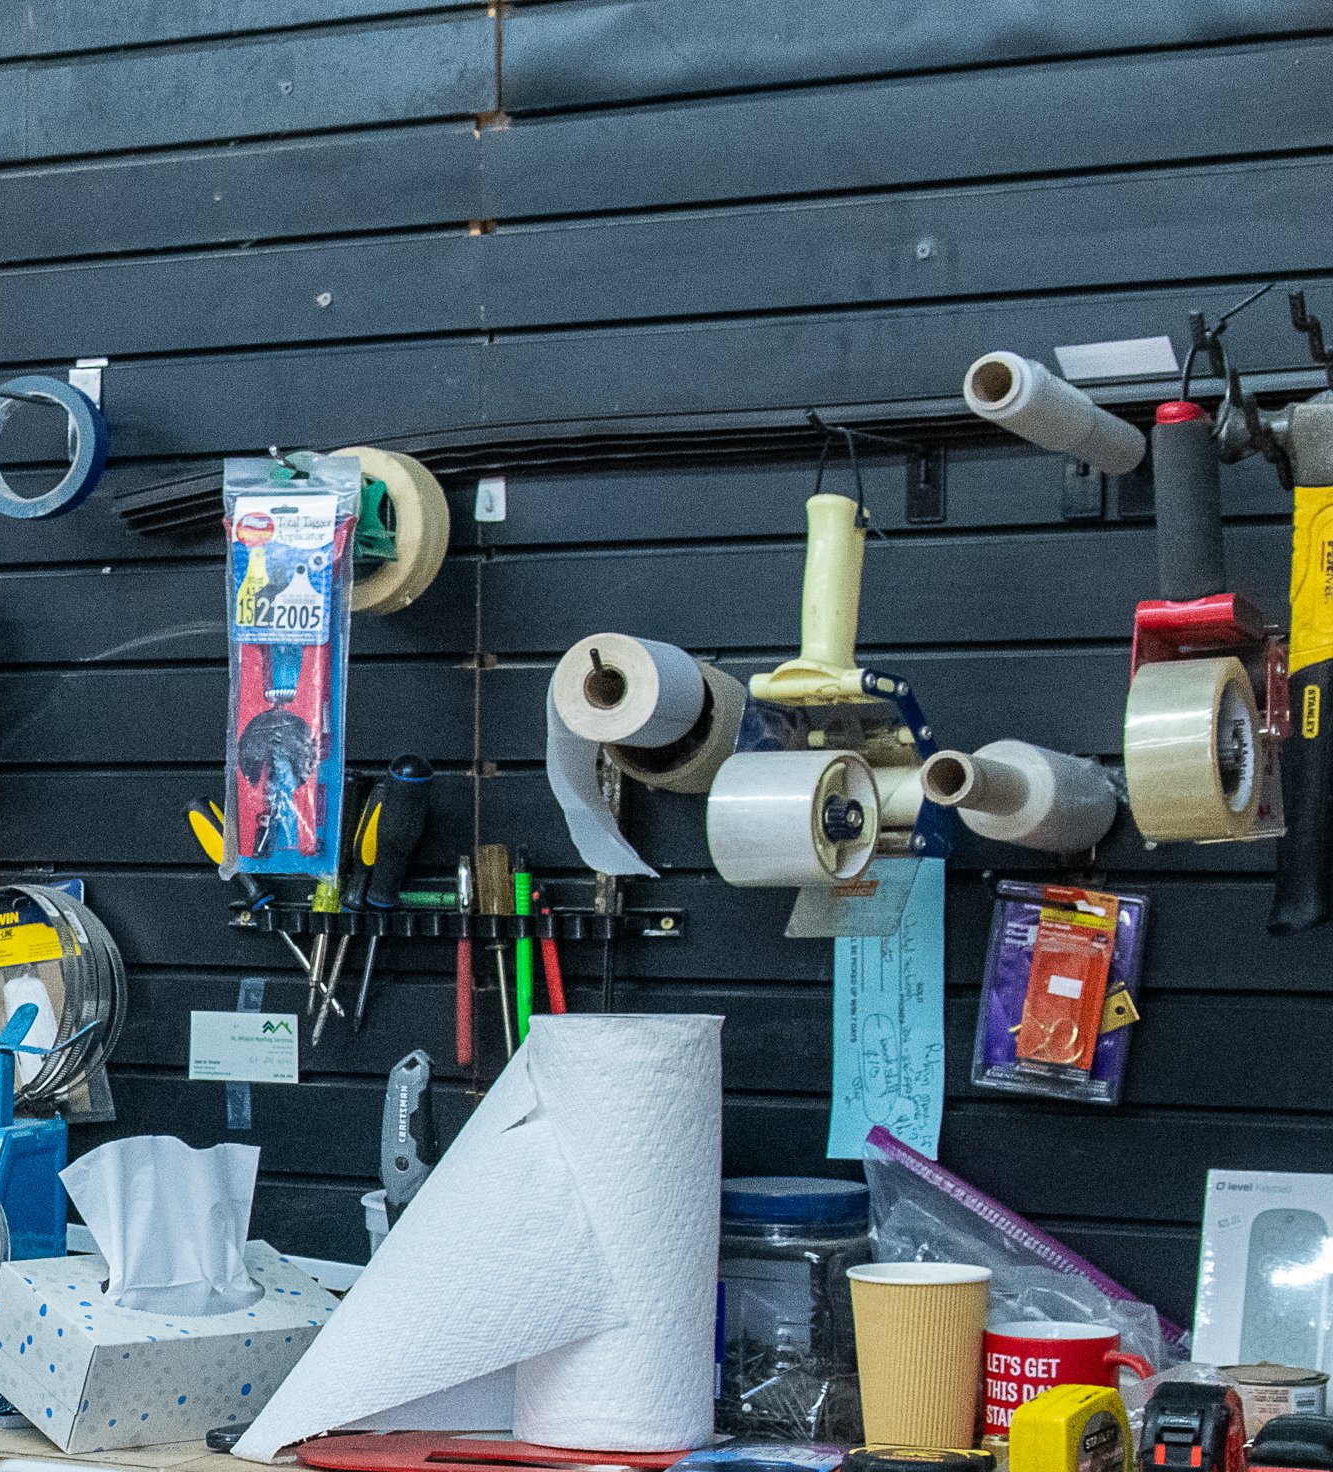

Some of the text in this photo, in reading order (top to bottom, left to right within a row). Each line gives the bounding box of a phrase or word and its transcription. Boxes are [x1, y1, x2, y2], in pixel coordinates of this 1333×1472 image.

[277, 517, 300, 528] Total
[302, 517, 332, 530] Tagger
[276, 530, 326, 543] Applicator
[275, 605, 322, 629] 2005
[1306, 689, 1315, 734] STANLEY
[398, 1085, 408, 1143] CRAFTSMAN
[1227, 1181, 1253, 1192] level
[986, 1352, 1061, 1379] LET'S GET
[986, 1378, 1055, 1403] THIS DA
